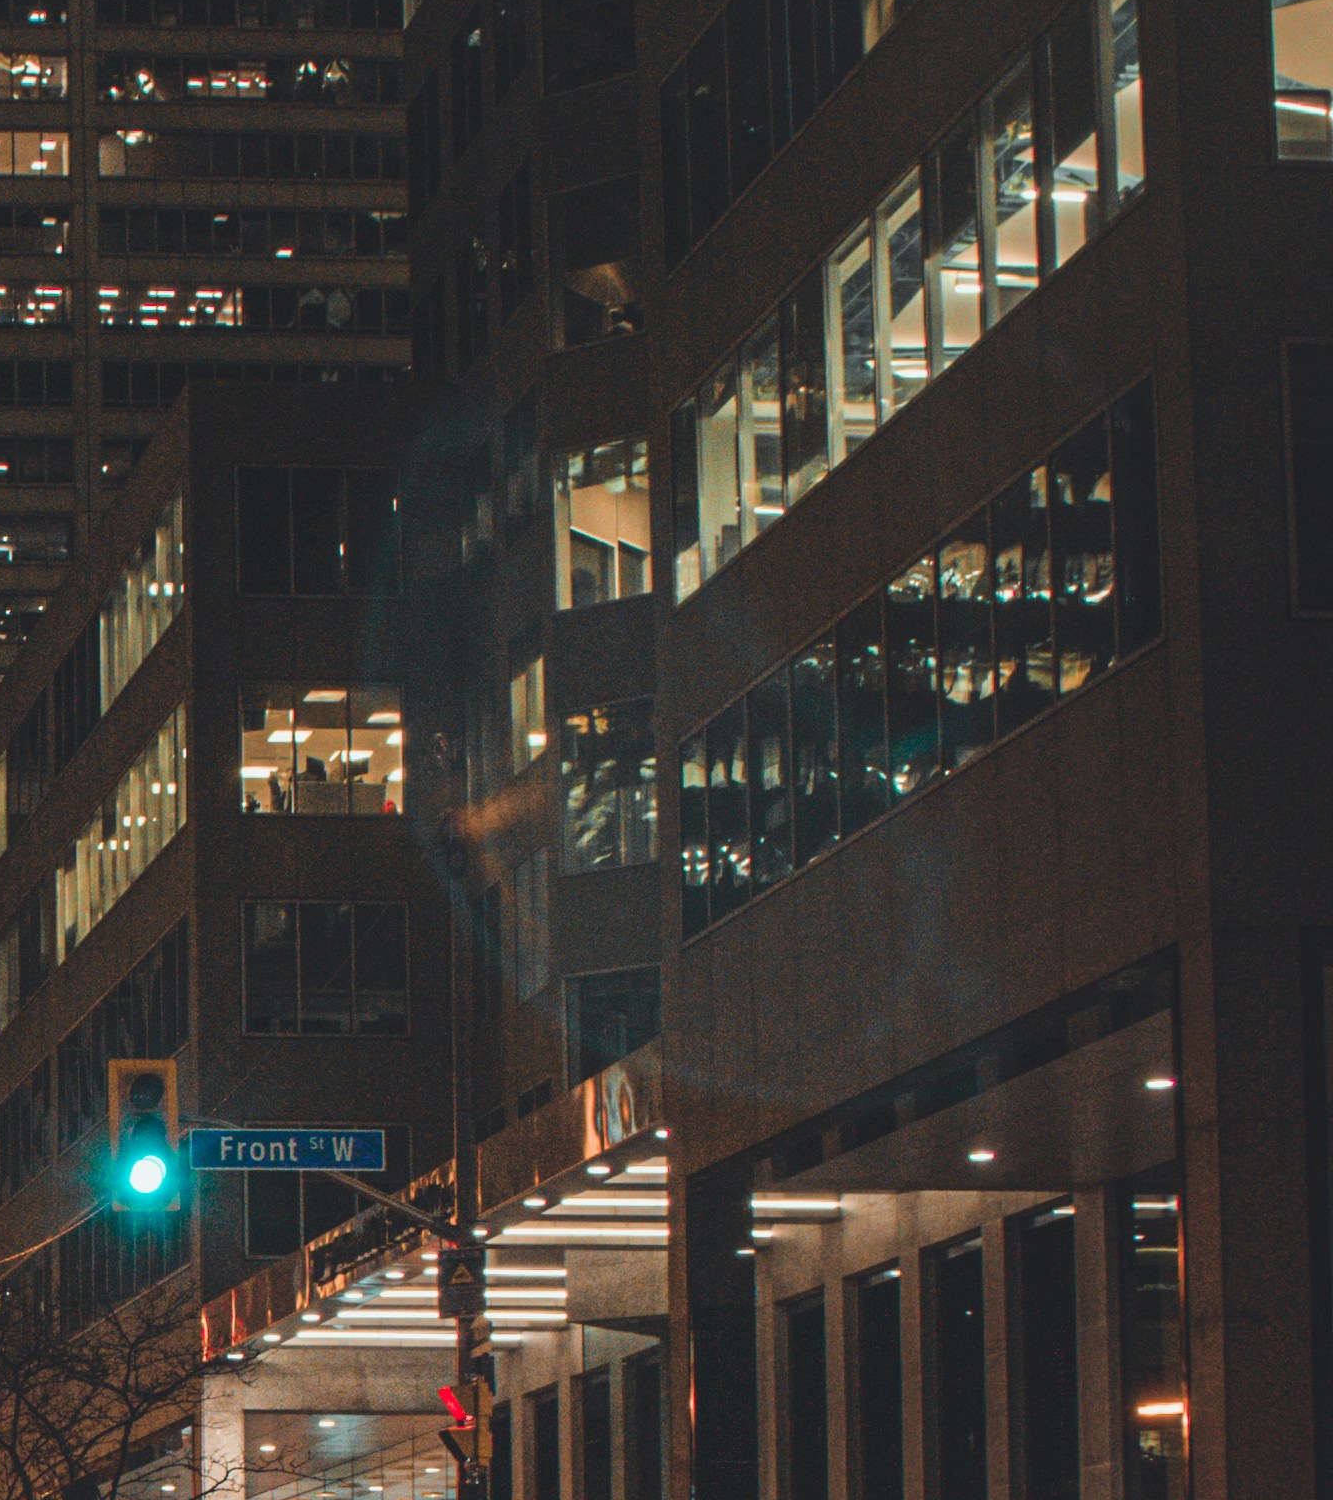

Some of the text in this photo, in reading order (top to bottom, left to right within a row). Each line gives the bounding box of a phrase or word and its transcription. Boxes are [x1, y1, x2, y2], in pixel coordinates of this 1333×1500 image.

[220, 1136, 355, 1162] Front St W
